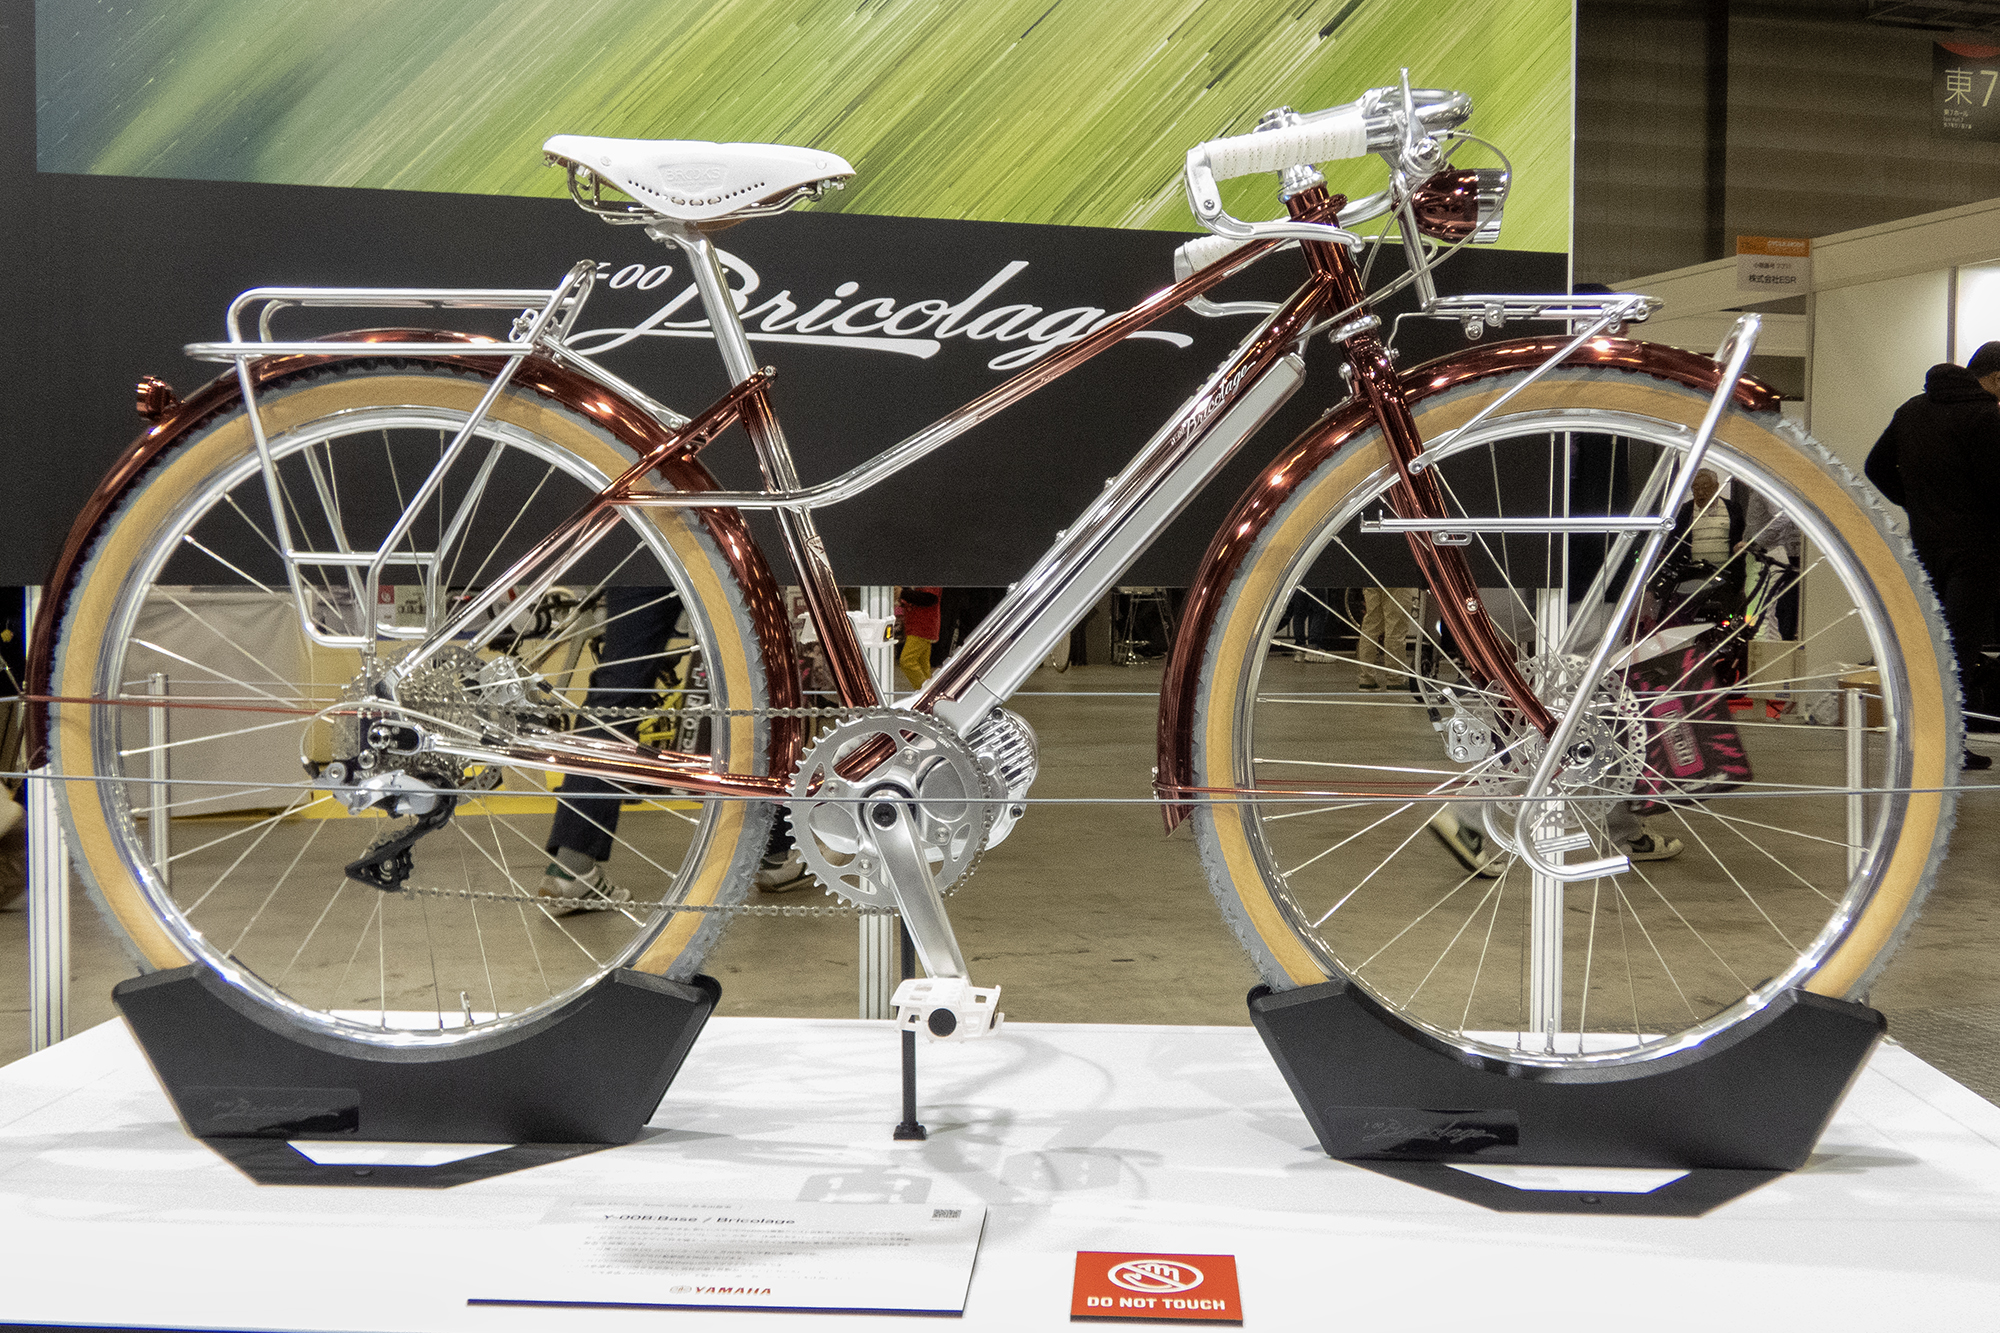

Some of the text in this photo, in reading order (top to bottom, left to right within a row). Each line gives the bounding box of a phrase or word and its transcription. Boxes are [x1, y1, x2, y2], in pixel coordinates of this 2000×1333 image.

[1944, 66, 1999, 107] 東7
[666, 167, 722, 181] BROOKS
[573, 262, 674, 291] -00
[1749, 274, 1797, 284] 株式会社ESR
[716, 1217, 796, 1225] Bricolage
[695, 1286, 772, 1295] YAMAHA
[1087, 1296, 1226, 1311] DO NOT TOUCH
